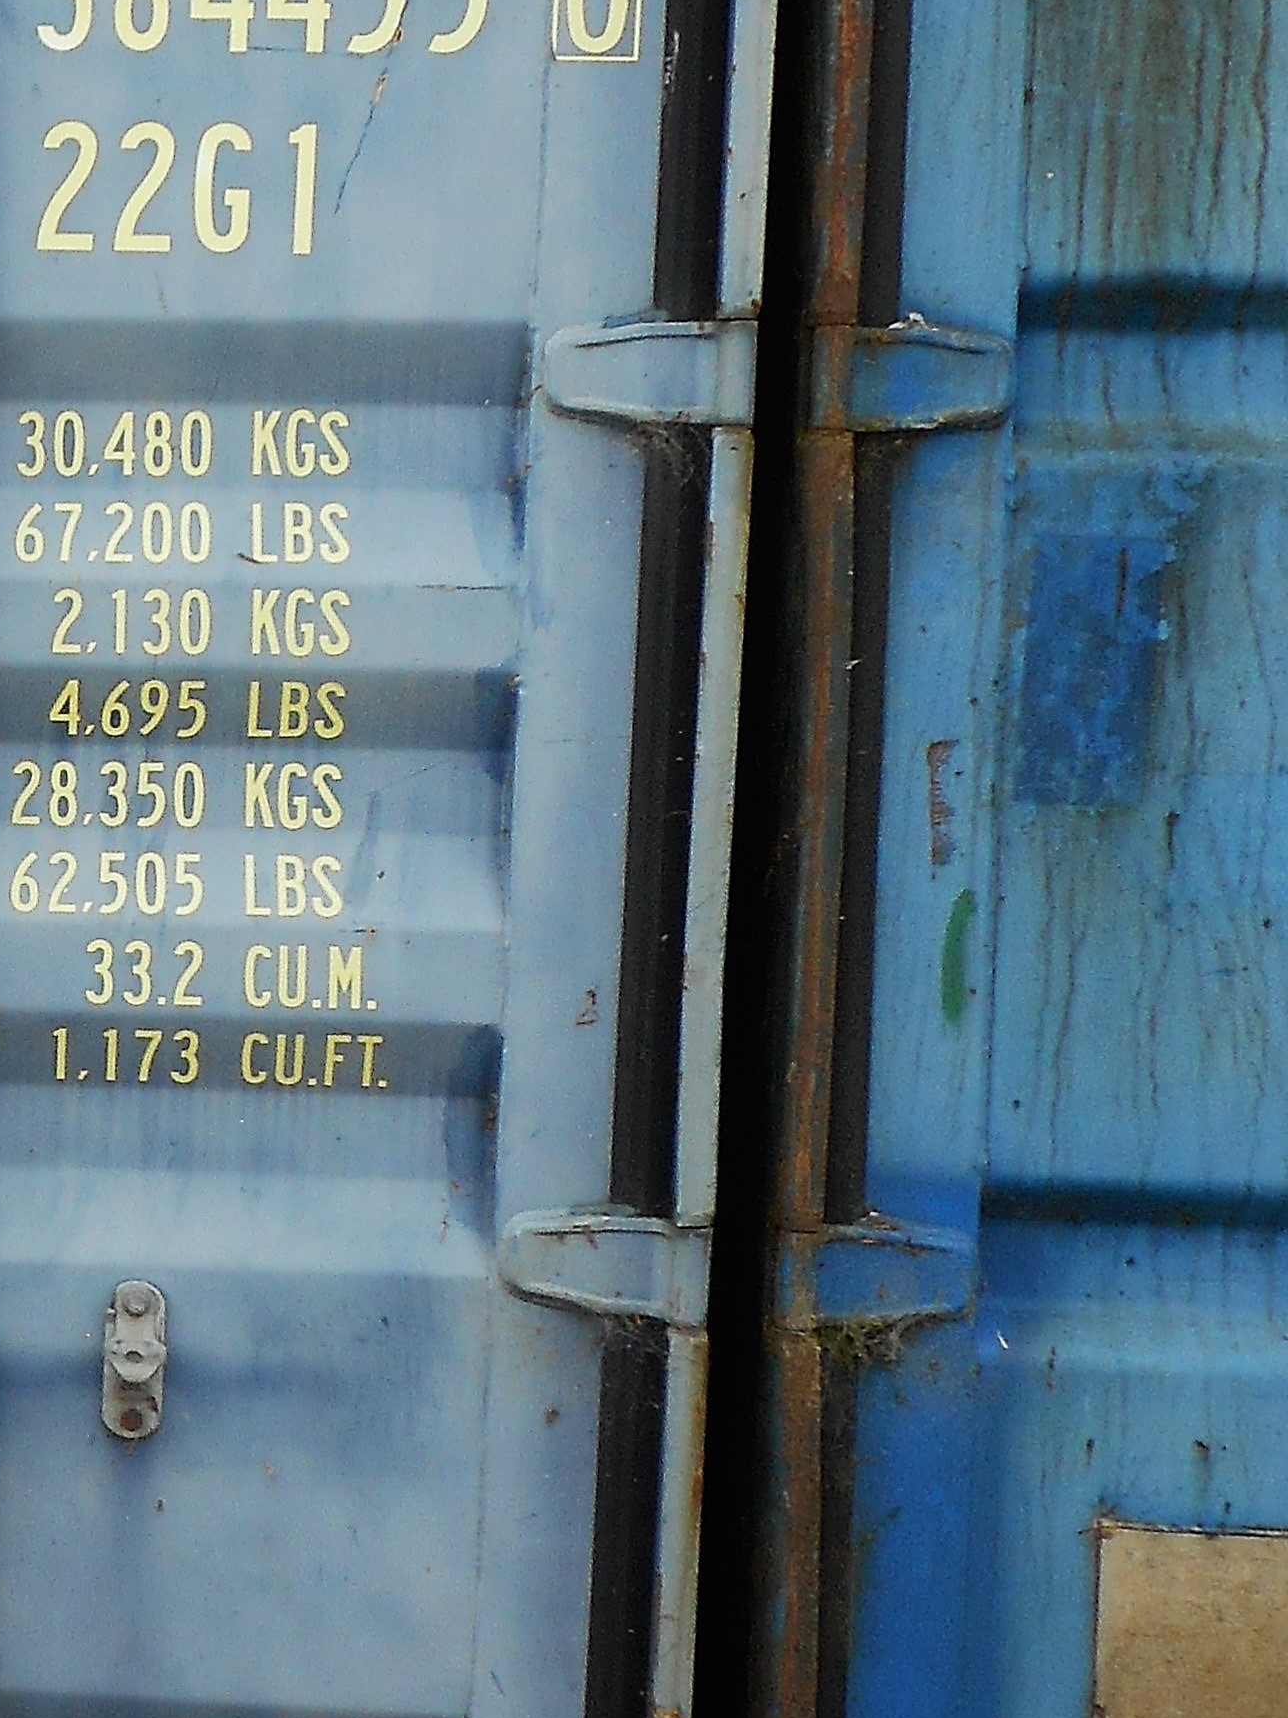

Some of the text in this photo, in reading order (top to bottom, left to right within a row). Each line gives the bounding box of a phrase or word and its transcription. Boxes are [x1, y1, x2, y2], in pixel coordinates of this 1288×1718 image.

[35, 118, 320, 256] 22G1
[15, 408, 352, 478] 30,480 KGS
[13, 501, 352, 565] 67,200 LBS
[50, 586, 352, 658] 2,130 KGS
[47, 677, 348, 740] 4,695 LBS
[10, 759, 344, 831] 28,350 KGS
[8, 850, 344, 918] 62,505 LBS
[84, 938, 380, 1011] 33.2 CU.M.
[50, 1026, 390, 1089] 1,173 CU.FT.
